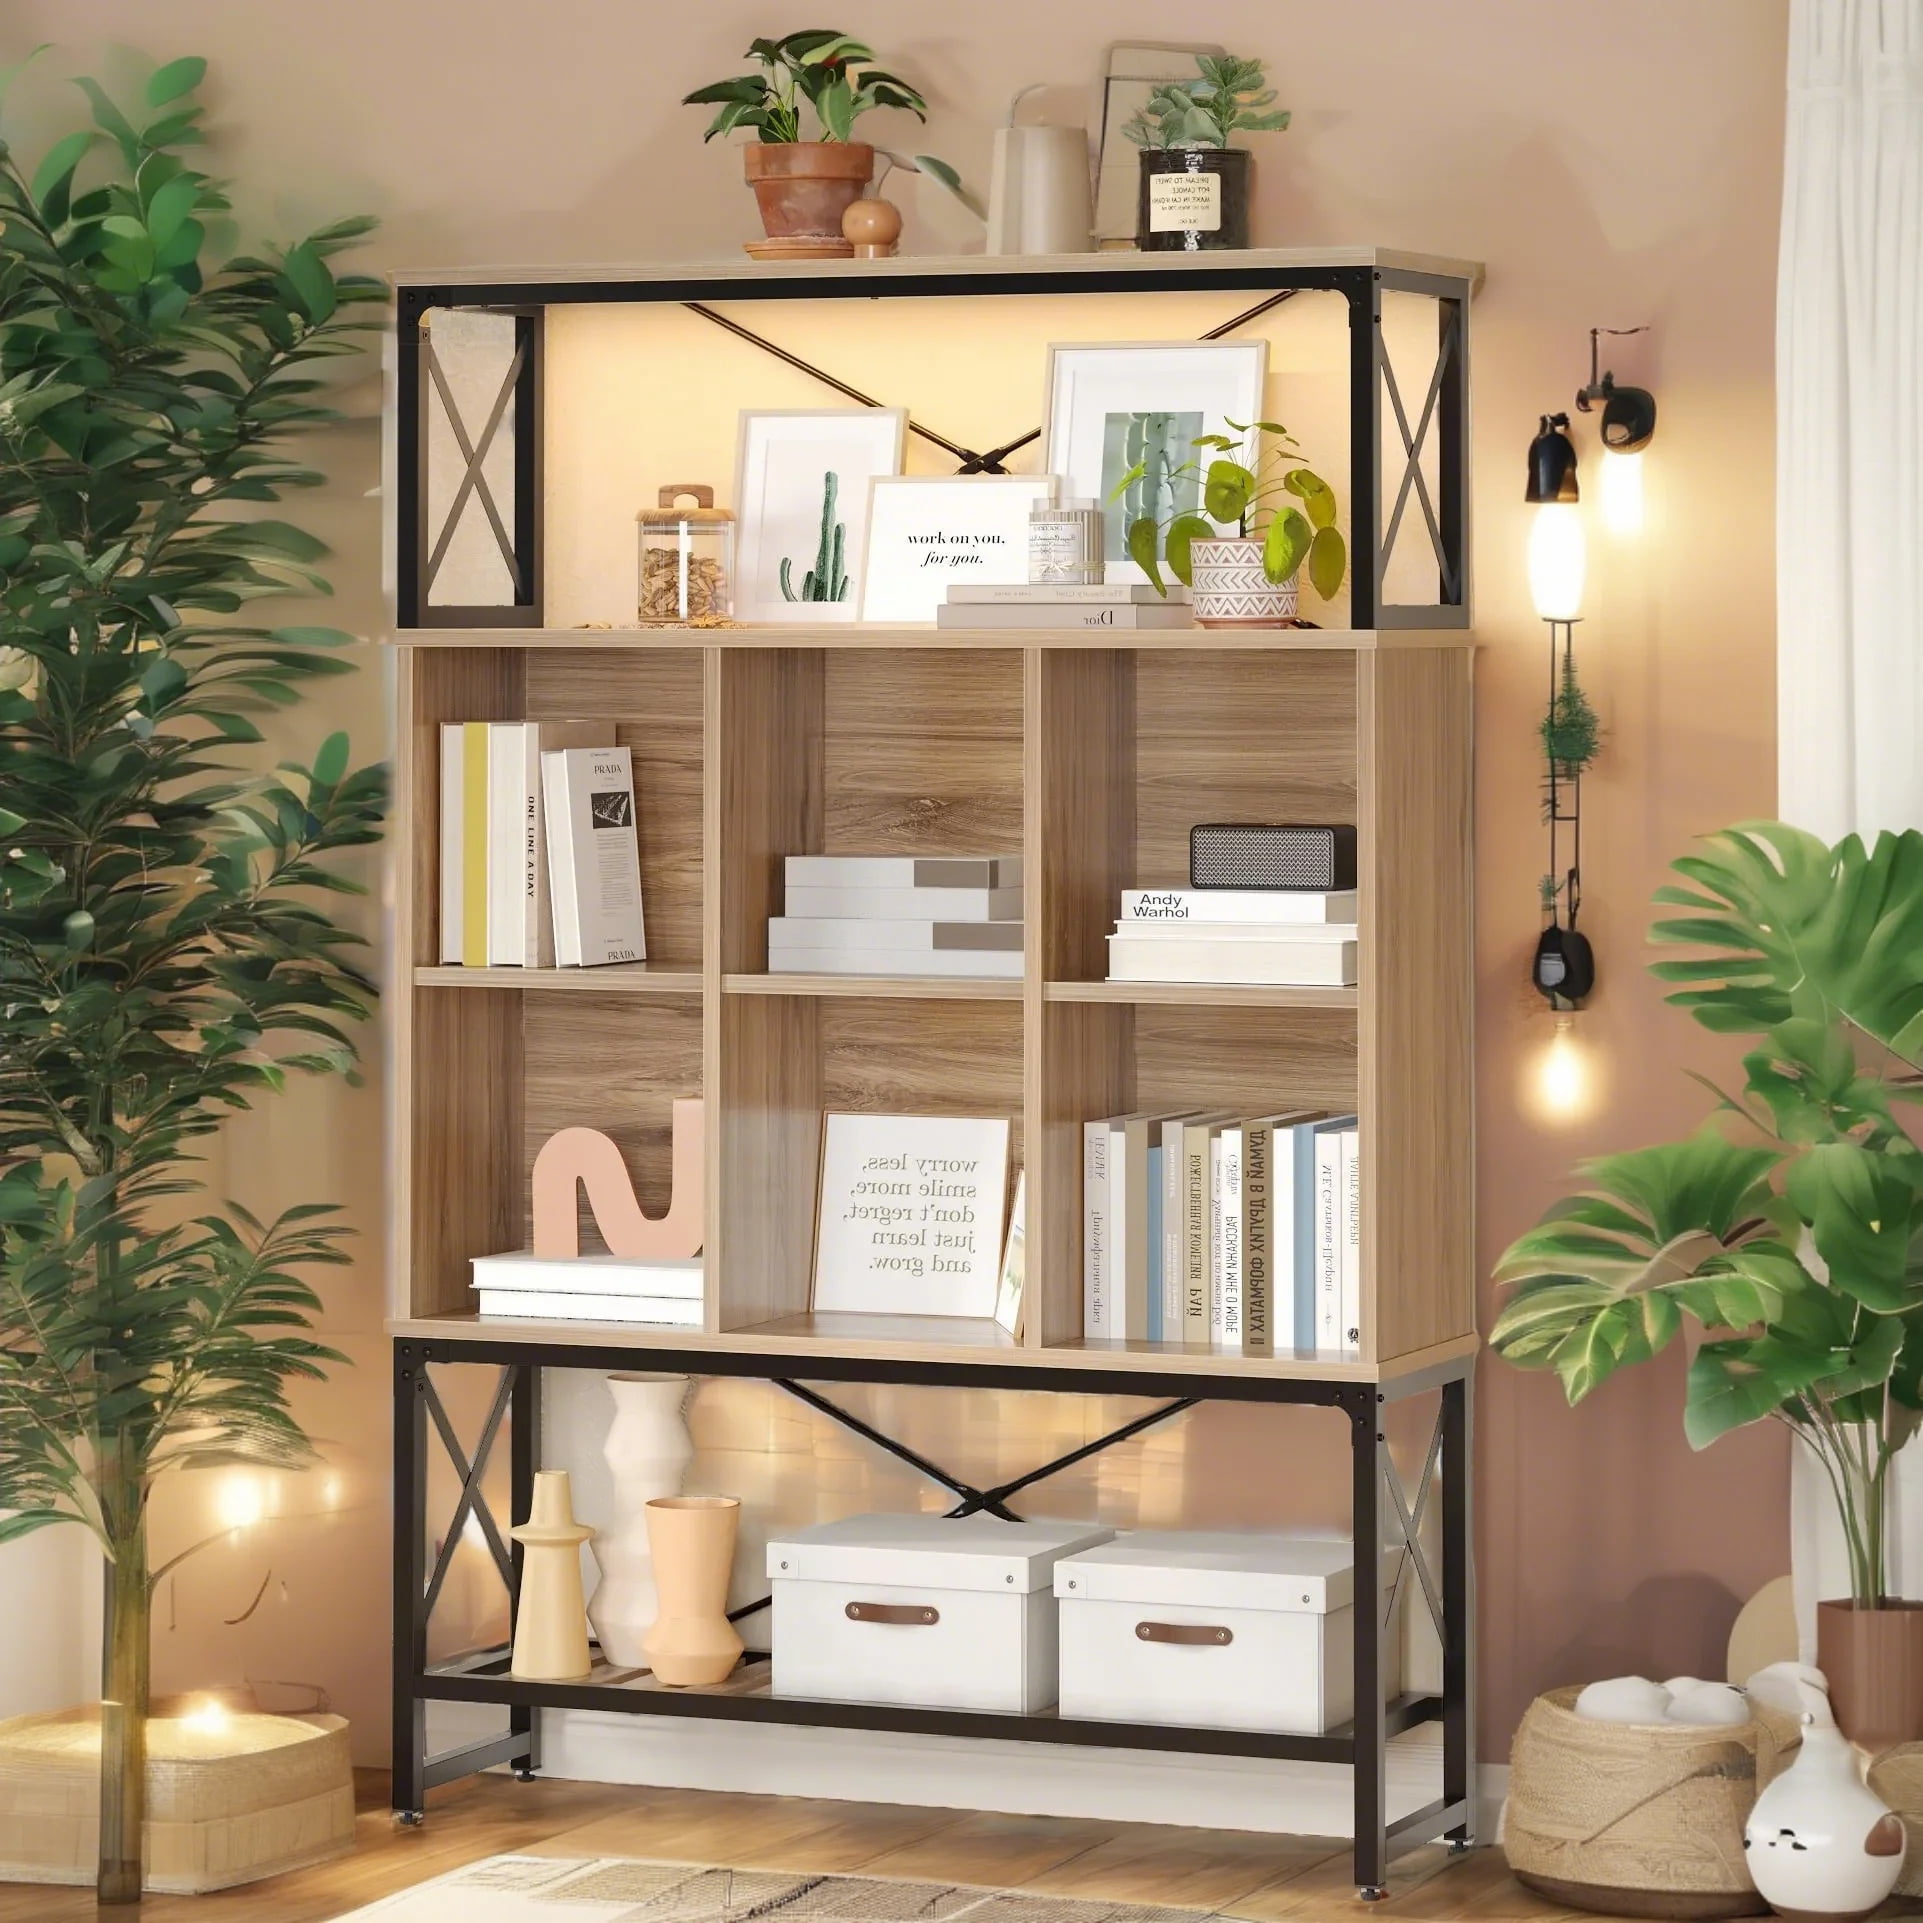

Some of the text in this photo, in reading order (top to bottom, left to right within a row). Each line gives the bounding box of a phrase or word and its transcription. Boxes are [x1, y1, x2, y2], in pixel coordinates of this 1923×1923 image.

[907, 531, 1006, 548] work on you.
[920, 551, 984, 567] for you.
[594, 764, 622, 775] PRADA
[528, 861, 534, 869] A
[1140, 894, 1182, 909] Andy
[1133, 906, 1189, 918] Warhol
[608, 949, 636, 961] PRADA
